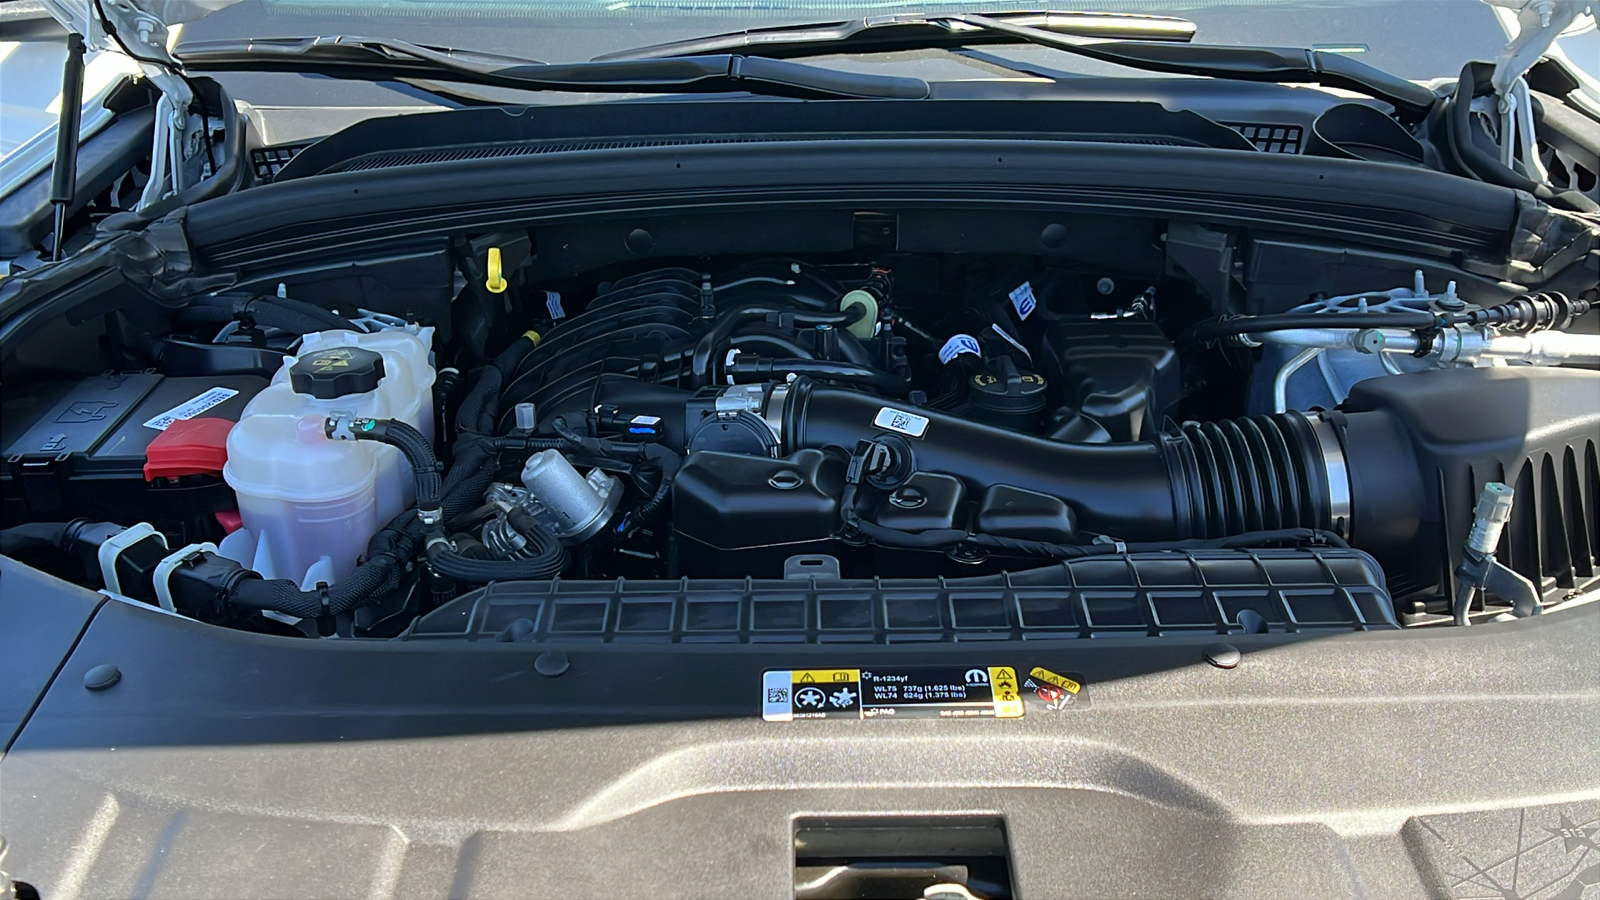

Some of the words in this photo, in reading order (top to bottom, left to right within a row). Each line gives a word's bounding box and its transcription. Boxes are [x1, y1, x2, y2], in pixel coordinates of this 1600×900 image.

[949, 684, 965, 692] lbs)
[950, 691, 966, 699] lbs)
[1560, 828, 1586, 838] 313
